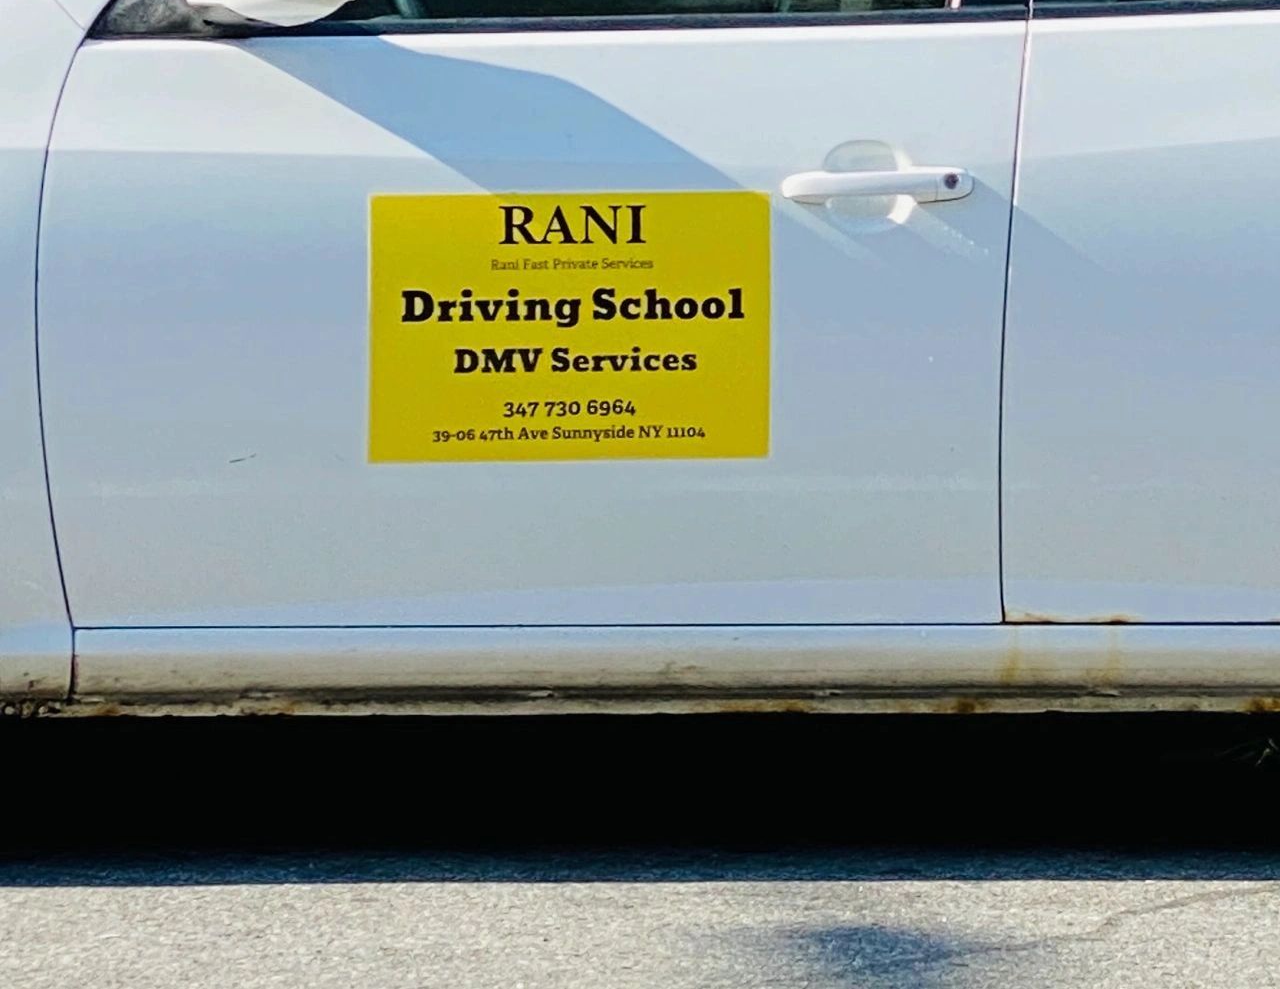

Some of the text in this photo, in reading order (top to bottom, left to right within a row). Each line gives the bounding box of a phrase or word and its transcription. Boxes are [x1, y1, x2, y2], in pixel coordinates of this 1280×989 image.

[498, 205, 647, 244] RANI
[491, 257, 654, 270] Rani Fast Private Services
[401, 287, 745, 327] Driving School
[453, 346, 698, 374] DMV Services
[503, 399, 636, 418] 347 730 6964
[432, 425, 706, 443] 39-06 47th Ave Sunnyside NY 11104
